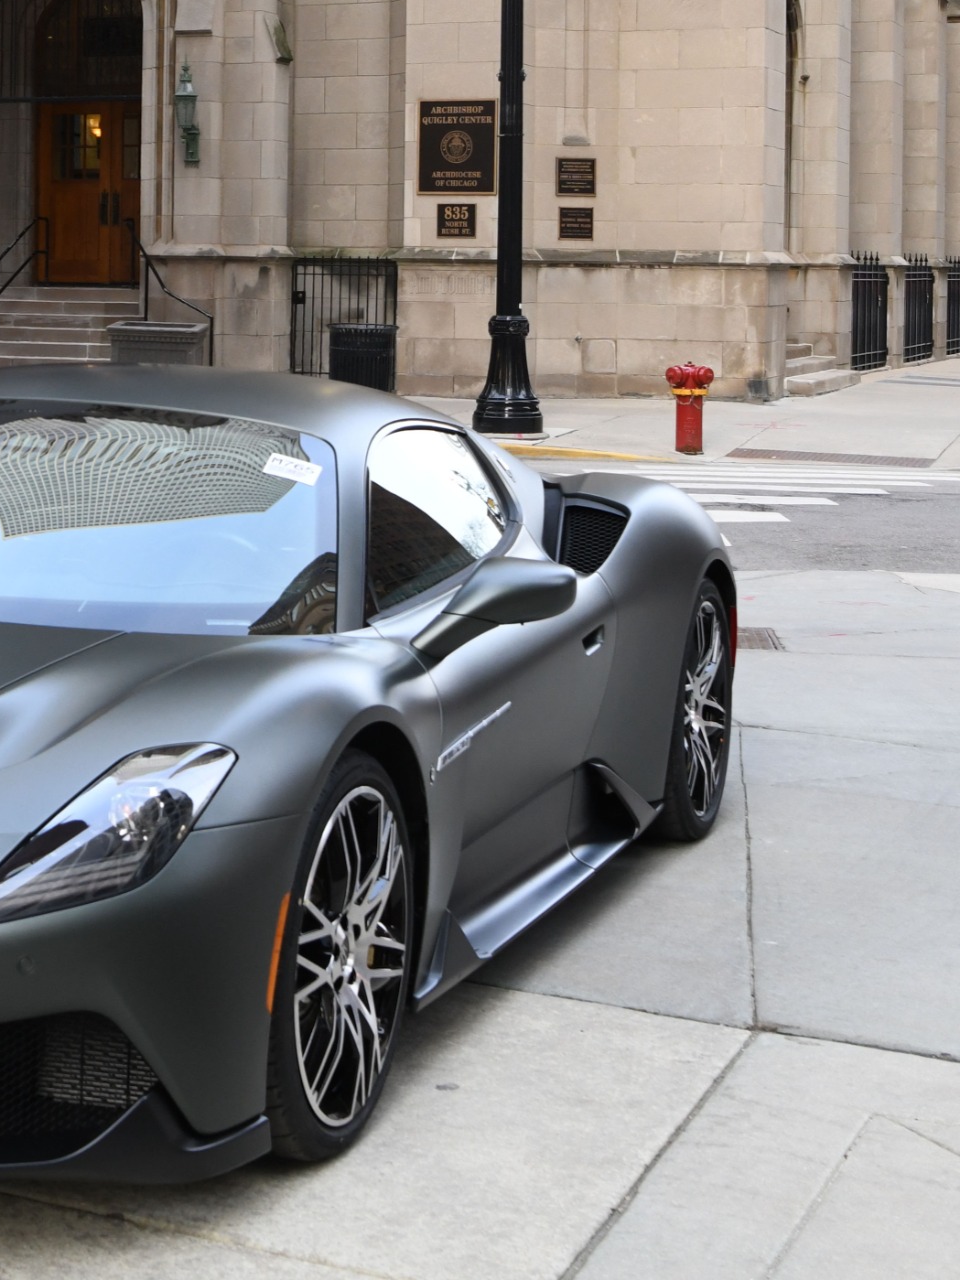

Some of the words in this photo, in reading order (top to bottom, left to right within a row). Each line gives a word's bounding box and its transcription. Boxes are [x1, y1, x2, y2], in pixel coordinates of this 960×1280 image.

[430, 105, 484, 114] ARCHBISHOP
[421, 116, 458, 125] QUIGLEY
[459, 116, 493, 124] CENTER
[445, 179, 478, 187] CHICAGO
[444, 206, 469, 220] 835
